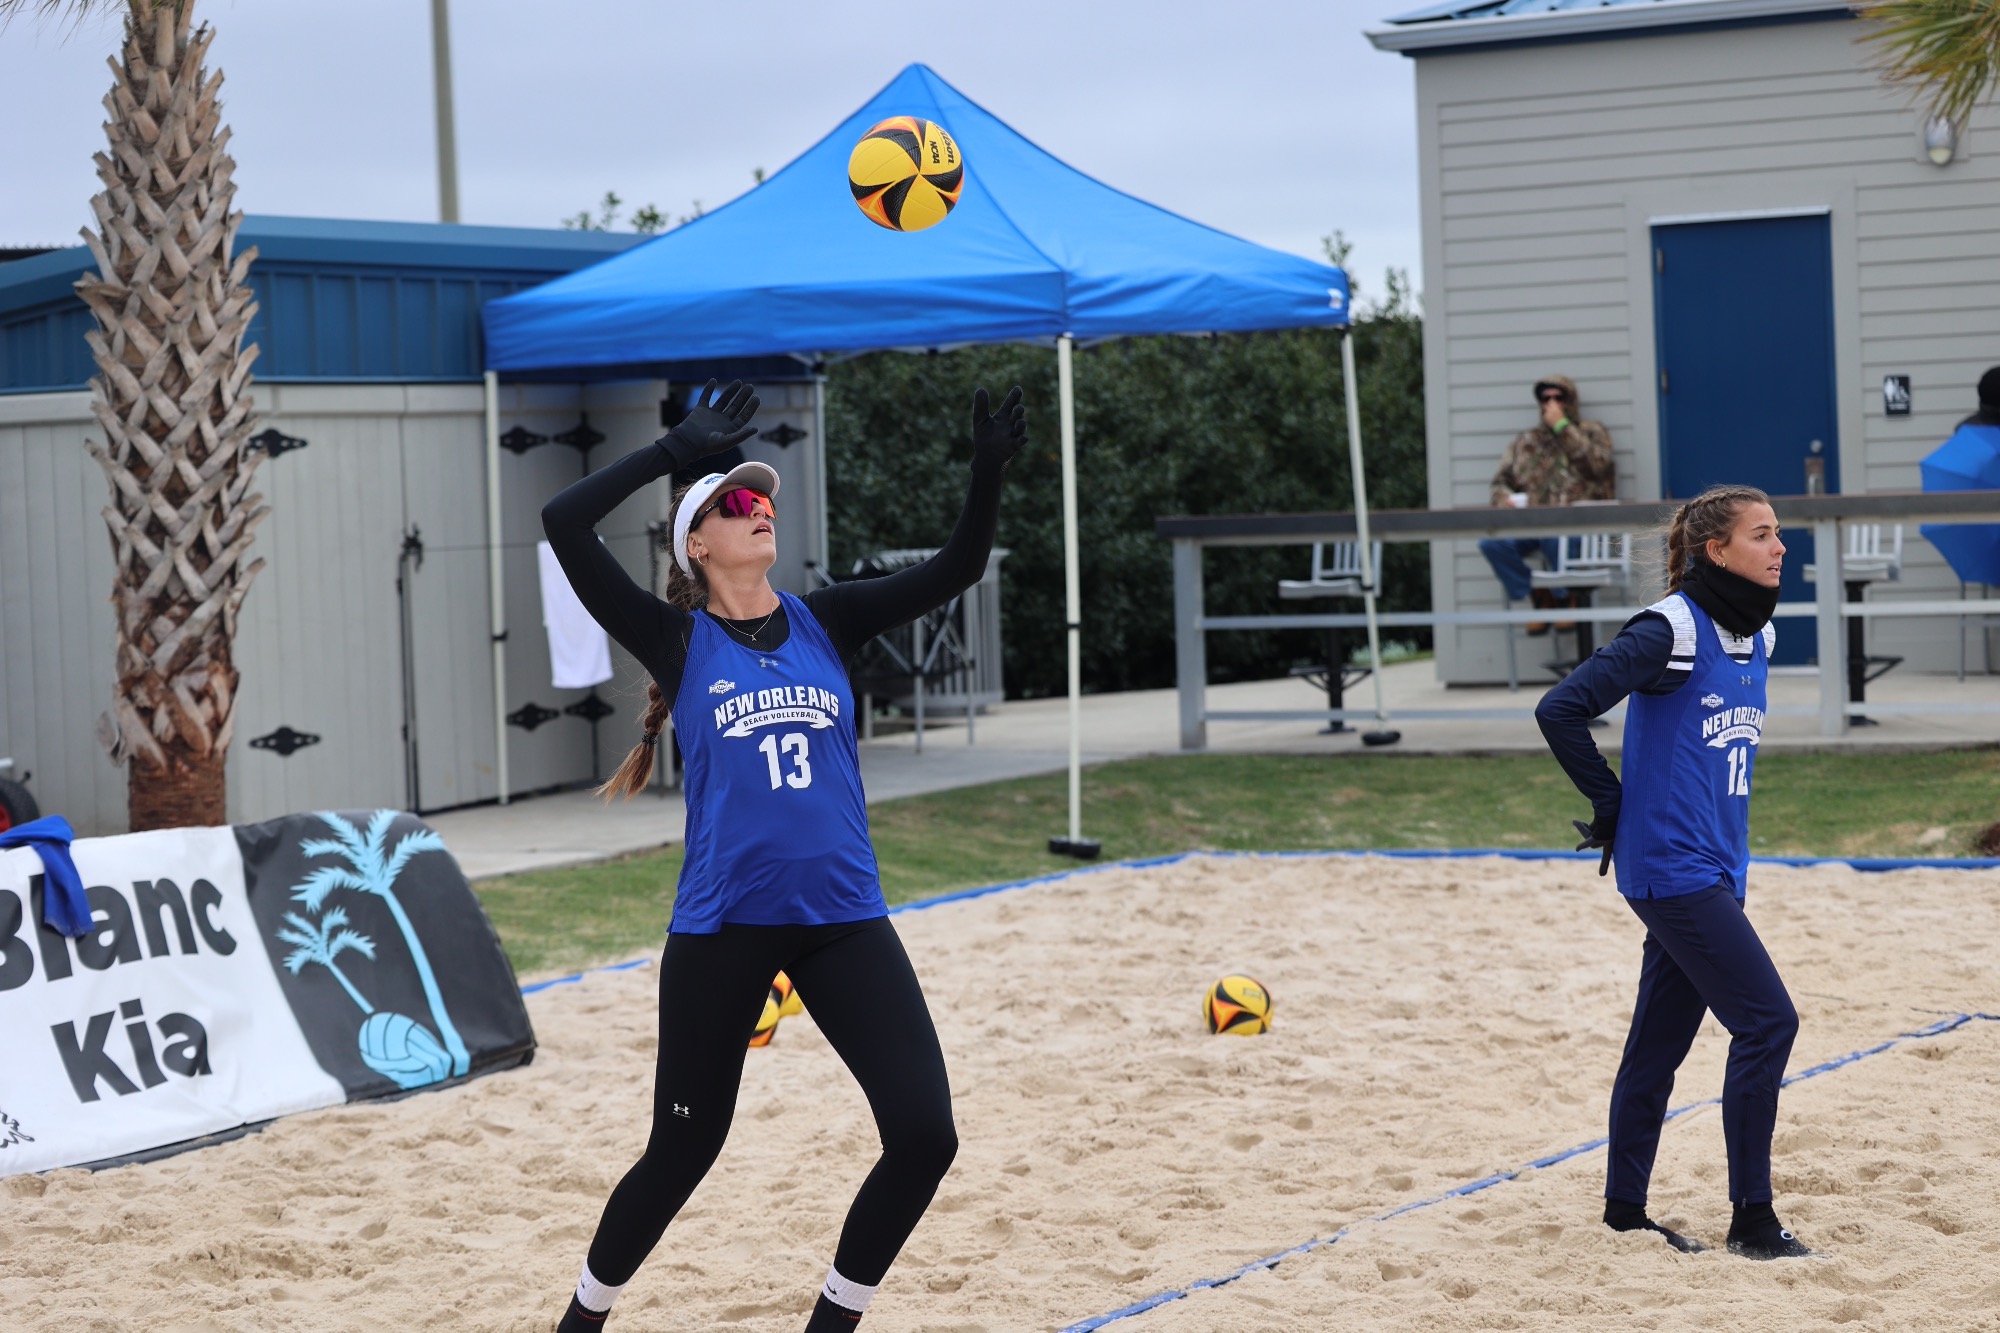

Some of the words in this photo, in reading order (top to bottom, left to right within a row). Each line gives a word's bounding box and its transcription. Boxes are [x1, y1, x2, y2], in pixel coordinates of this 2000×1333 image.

[929, 140, 940, 164] NCAA
[714, 692, 755, 730] NEW
[758, 686, 839, 717] ORLEANS
[743, 714, 769, 728] BEACH
[771, 711, 818, 720] VOLLEYBALL
[1702, 708, 1732, 739] NEW
[1734, 706, 1764, 732] ORLEAN
[758, 732, 812, 791] 13
[1727, 746, 1749, 796] 12
[50, 997, 213, 1104] Kia
